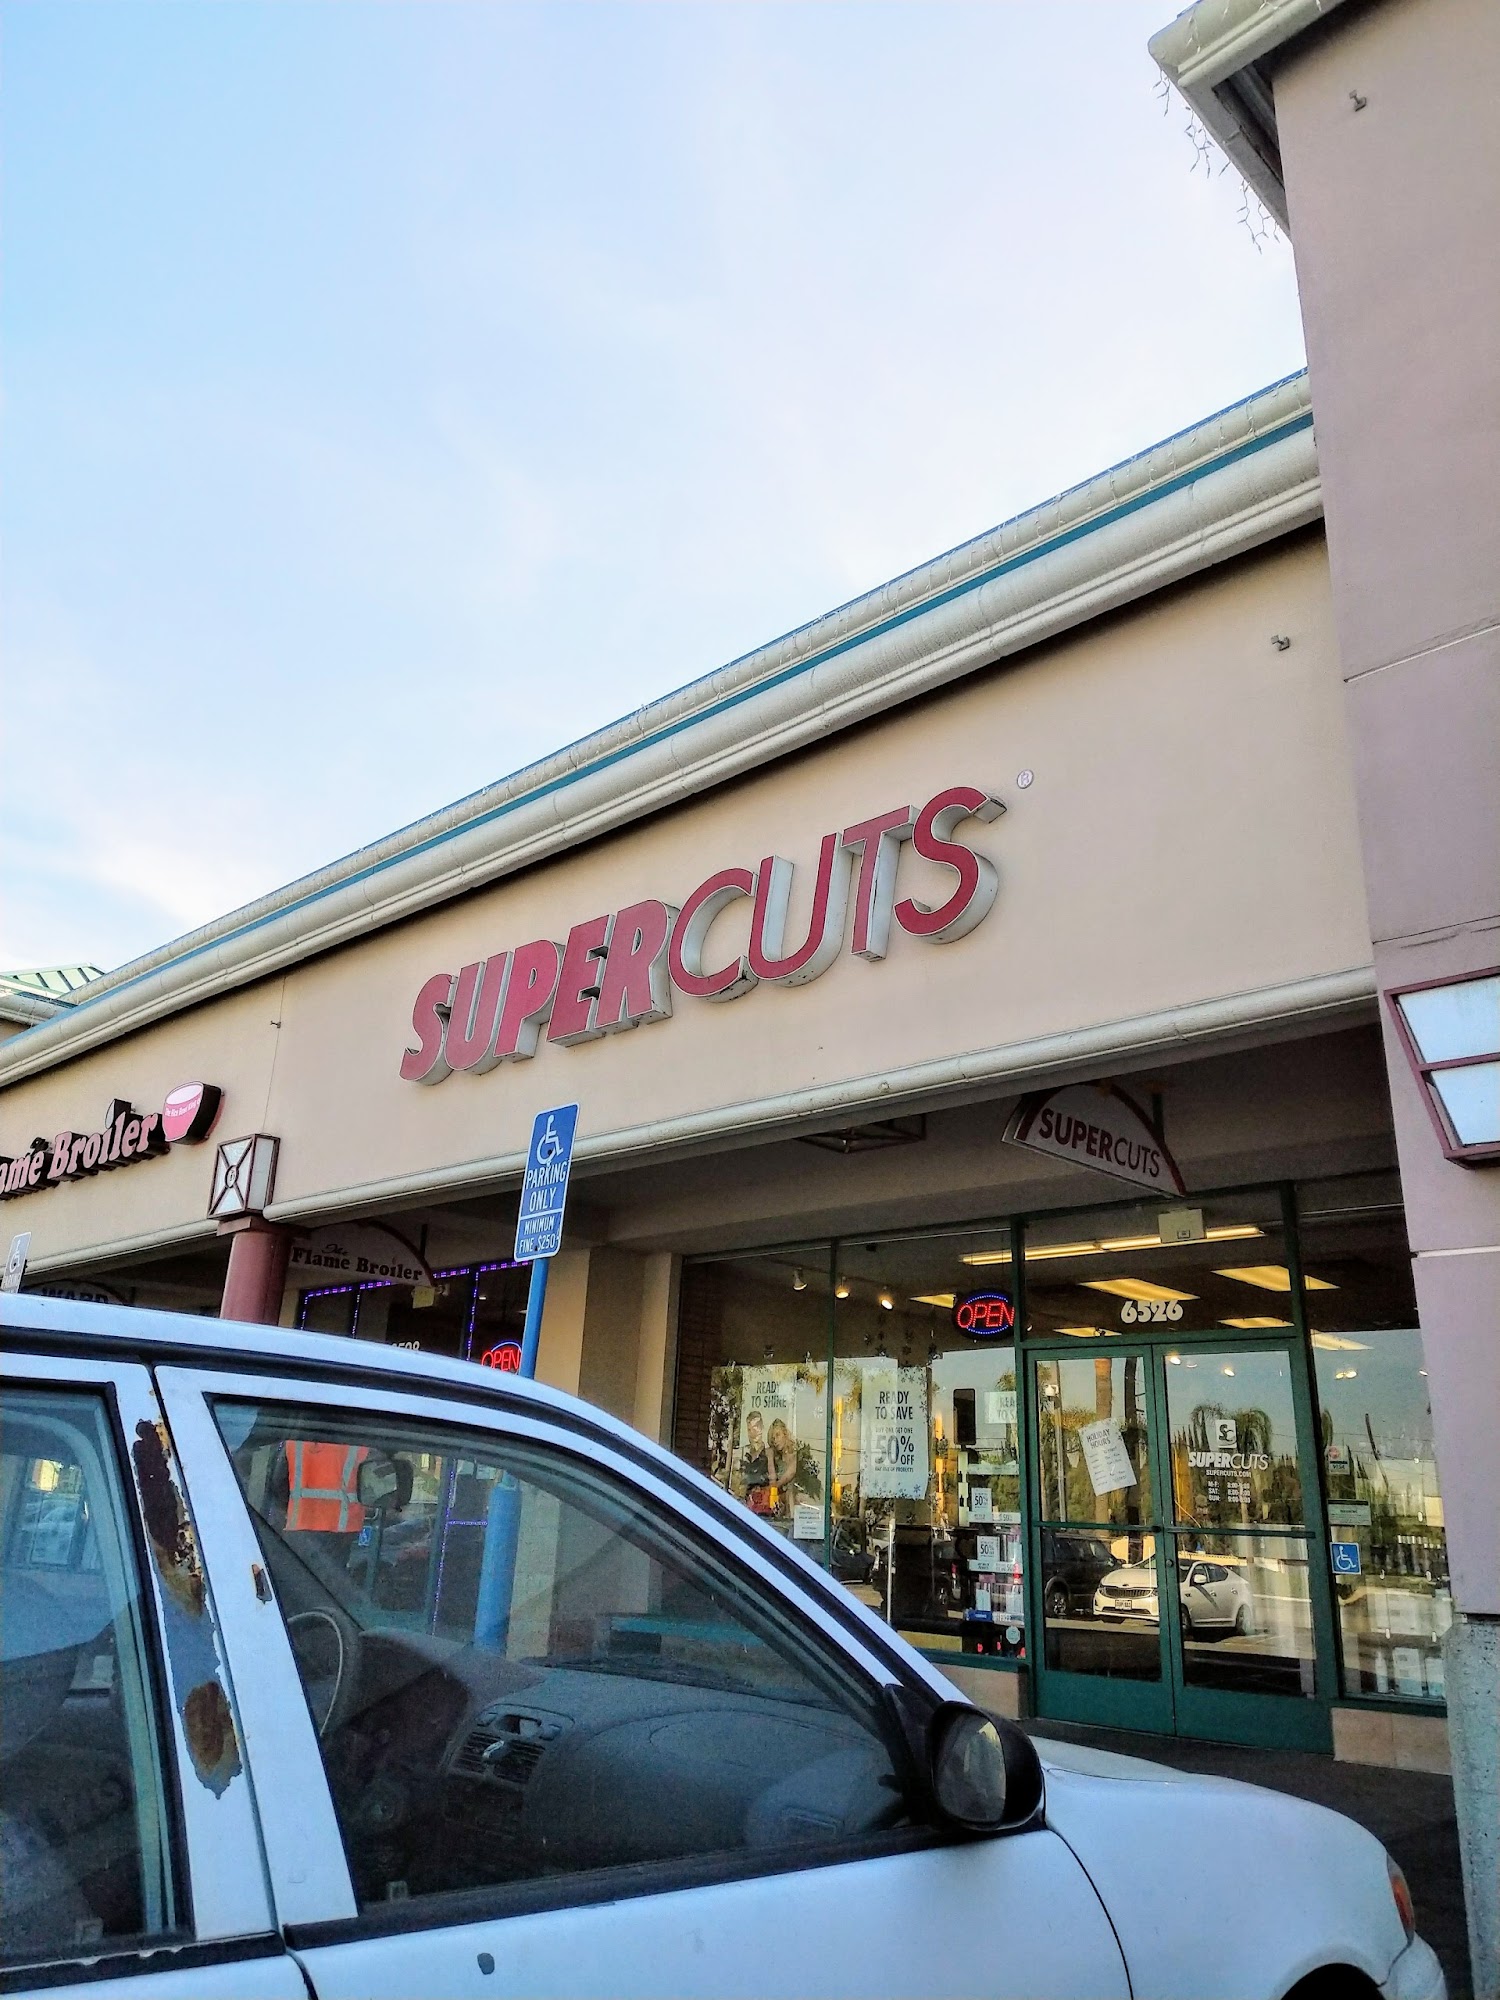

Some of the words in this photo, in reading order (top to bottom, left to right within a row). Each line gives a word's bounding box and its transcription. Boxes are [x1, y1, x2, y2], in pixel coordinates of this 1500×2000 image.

[399, 785, 1006, 1086] SUPERCUTS
[47, 1100, 159, 1180] Broiler
[1038, 1107, 1161, 1178] SUPERCUTS
[526, 1162, 568, 1190] PARKING
[529, 1186, 557, 1213] ONLY
[524, 1214, 555, 1236] MINIMUM
[518, 1238, 534, 1255] FINE
[536, 1233, 556, 1253] $250
[291, 1246, 350, 1270] Flame
[355, 1256, 423, 1281] Broiler
[957, 1301, 1015, 1328] OPEN
[1120, 1300, 1184, 1324] 6526
[481, 1349, 521, 1372] OPEN
[756, 1381, 782, 1394] READY
[879, 1391, 910, 1405] READY
[751, 1396, 762, 1408] TO
[763, 1395, 787, 1408] SHINE
[875, 1406, 888, 1420] TO
[890, 1406, 914, 1420] SAVE
[1086, 1428, 1110, 1443] HOLIDAY
[1090, 1437, 1111, 1449] HOURS
[900, 1454, 915, 1465] OFF
[1188, 1451, 1269, 1471] SUPERCUTS
[1206, 1469, 1252, 1478] SUPERCUTS.COM
